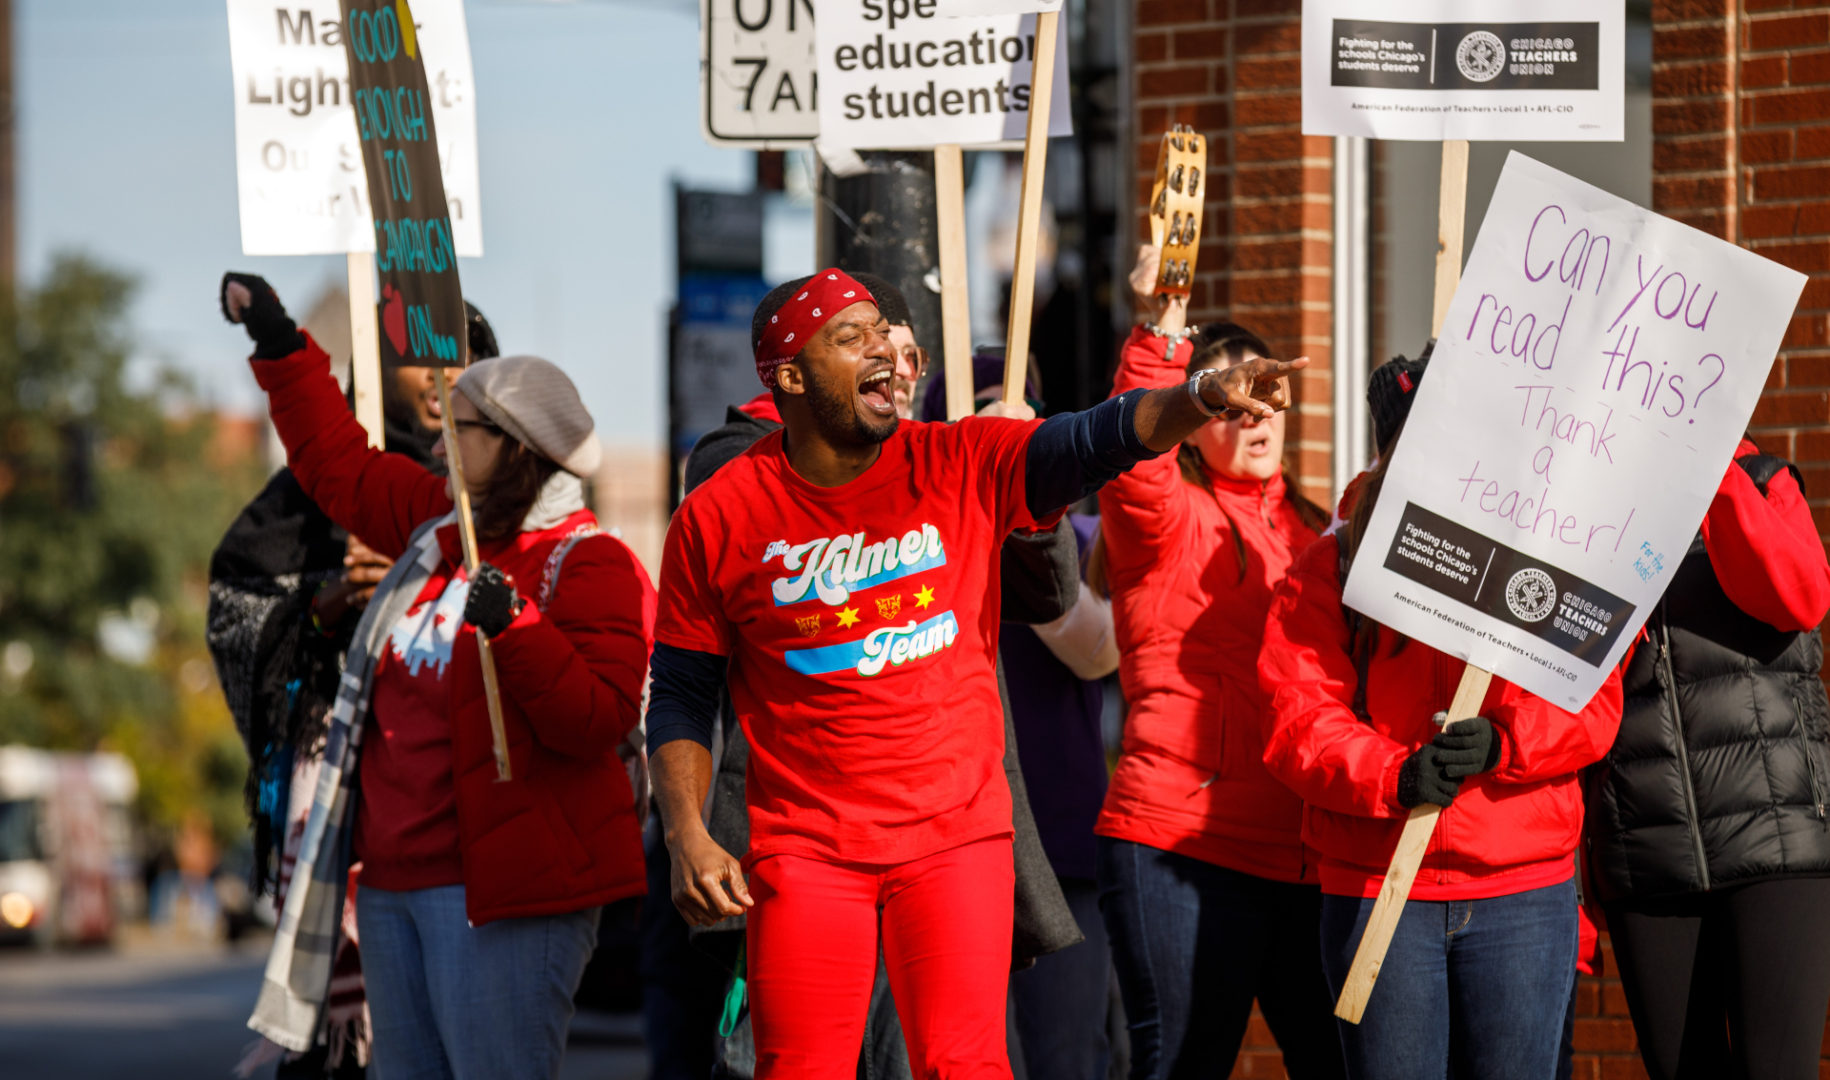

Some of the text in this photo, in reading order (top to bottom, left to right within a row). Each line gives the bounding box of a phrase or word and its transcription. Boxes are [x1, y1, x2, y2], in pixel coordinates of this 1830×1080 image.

[350, 5, 399, 63] GOOD
[834, 29, 1035, 71] educatio
[1339, 37, 1414, 50] Fighting for the
[1510, 38, 1575, 50] CHICAGO
[1338, 49, 1425, 63] schools Chicago's
[1338, 60, 1419, 73] students deserve
[1509, 63, 1554, 75] UNION
[1510, 51, 1578, 62] TEACHERS
[733, 57, 818, 111] 7A
[843, 79, 1031, 121] students
[355, 86, 428, 141] ENOUGH
[1351, 102, 1393, 112] American
[1395, 103, 1441, 113] Federation
[1443, 105, 1452, 113] of
[1453, 105, 1491, 113] Teachers
[1499, 105, 1522, 113] Local
[1536, 105, 1574, 113] AFL-CIO
[384, 149, 412, 202] TO
[374, 216, 457, 273] CAMPAIGN
[1523, 204, 1718, 334] Can you
[1466, 291, 1726, 425] read this?
[1514, 385, 1616, 464] Thank
[1532, 445, 1554, 484] a
[1458, 461, 1636, 553] teacher!
[1401, 535, 1478, 576] schools Chicago's
[1405, 523, 1471, 559] Fighting for the
[762, 523, 943, 606] The Kilmer
[1397, 546, 1469, 584] students deserve
[1559, 603, 1608, 636] TEACHERS
[1562, 592, 1612, 623] CHICAGO
[857, 620, 955, 677] Team
[1393, 592, 1432, 614] American
[1432, 609, 1476, 634] Federation
[1476, 630, 1487, 639] of
[1488, 633, 1524, 656] Teachers
[1530, 652, 1548, 667] Local
[1555, 666, 1578, 682] AFL-CIO
[1553, 616, 1588, 642] UNION
